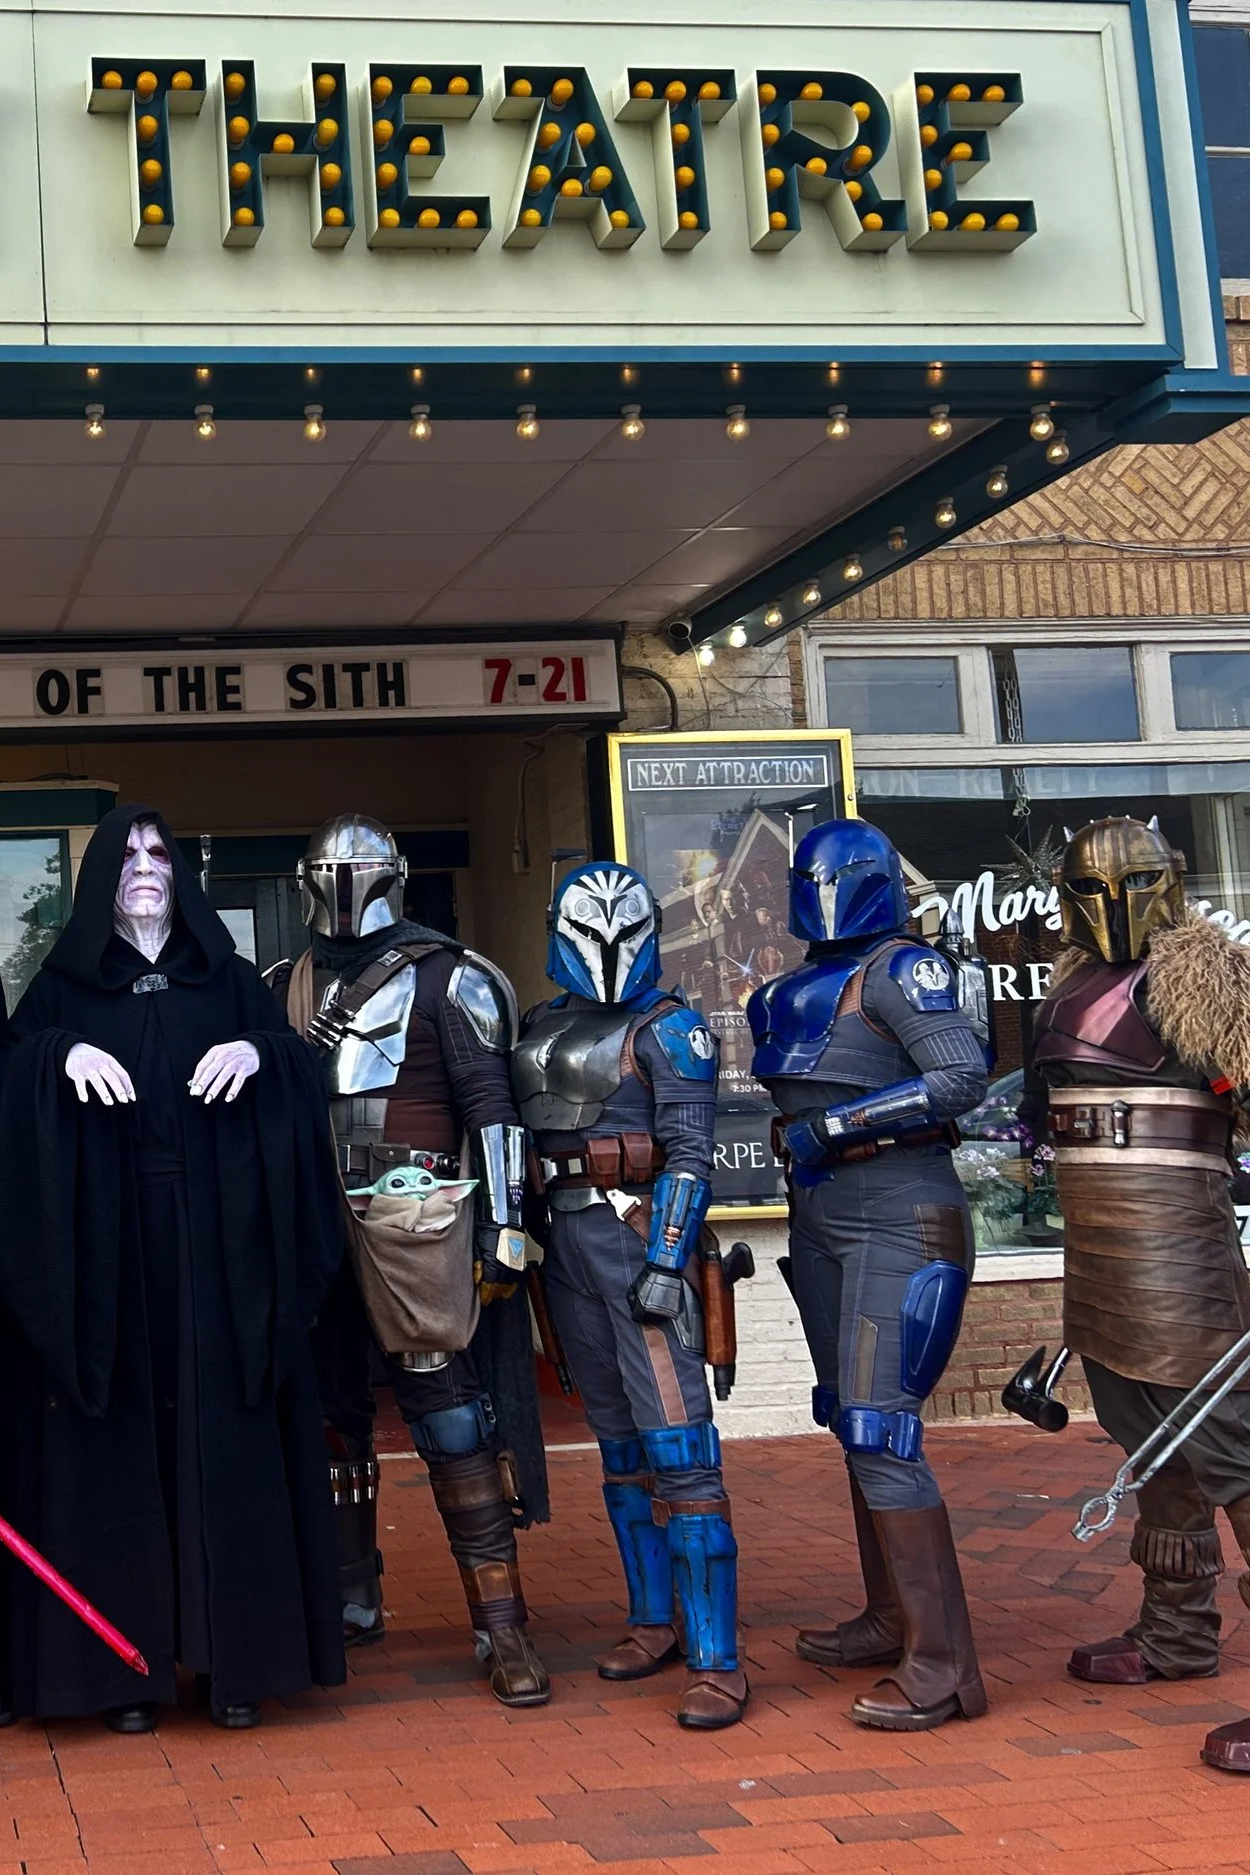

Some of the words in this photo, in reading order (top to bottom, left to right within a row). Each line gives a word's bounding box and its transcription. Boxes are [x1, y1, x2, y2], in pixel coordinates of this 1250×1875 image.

[85, 57, 1038, 252] THEATRE
[36, 667, 103, 715] OF
[143, 665, 243, 712] THE
[286, 661, 406, 709] SITH
[484, 656, 588, 704] 7-21
[637, 762, 687, 786] NEXT
[696, 760, 815, 785] ATTRACTION
[710, 1016, 750, 1028] EPISO
